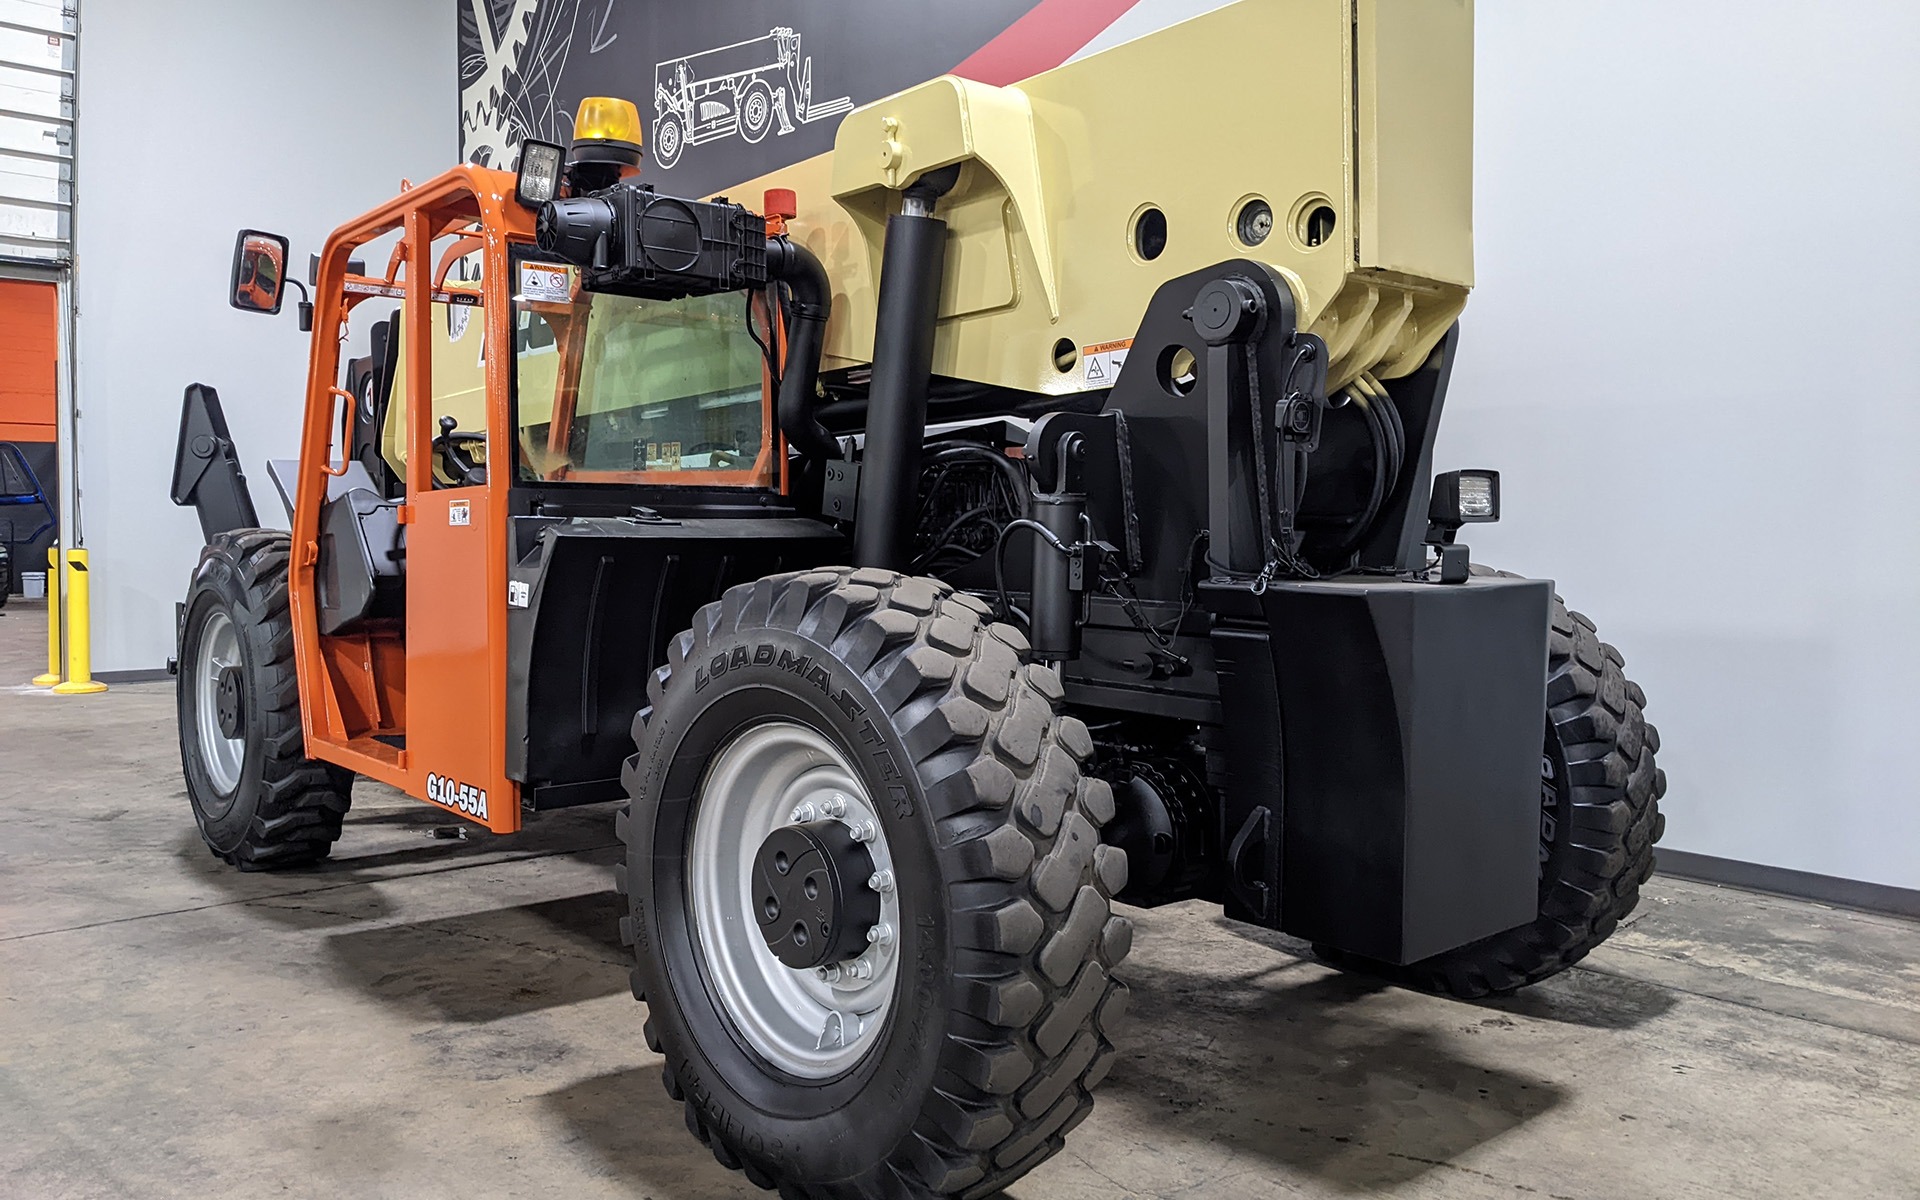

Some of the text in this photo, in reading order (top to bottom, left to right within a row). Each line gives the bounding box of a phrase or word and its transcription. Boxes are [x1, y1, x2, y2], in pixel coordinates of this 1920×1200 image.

[534, 264, 562, 273] WARNING
[1099, 341, 1126, 351] WARNING
[695, 644, 914, 821] LOADMASTER
[426, 772, 488, 821] G10-55A
